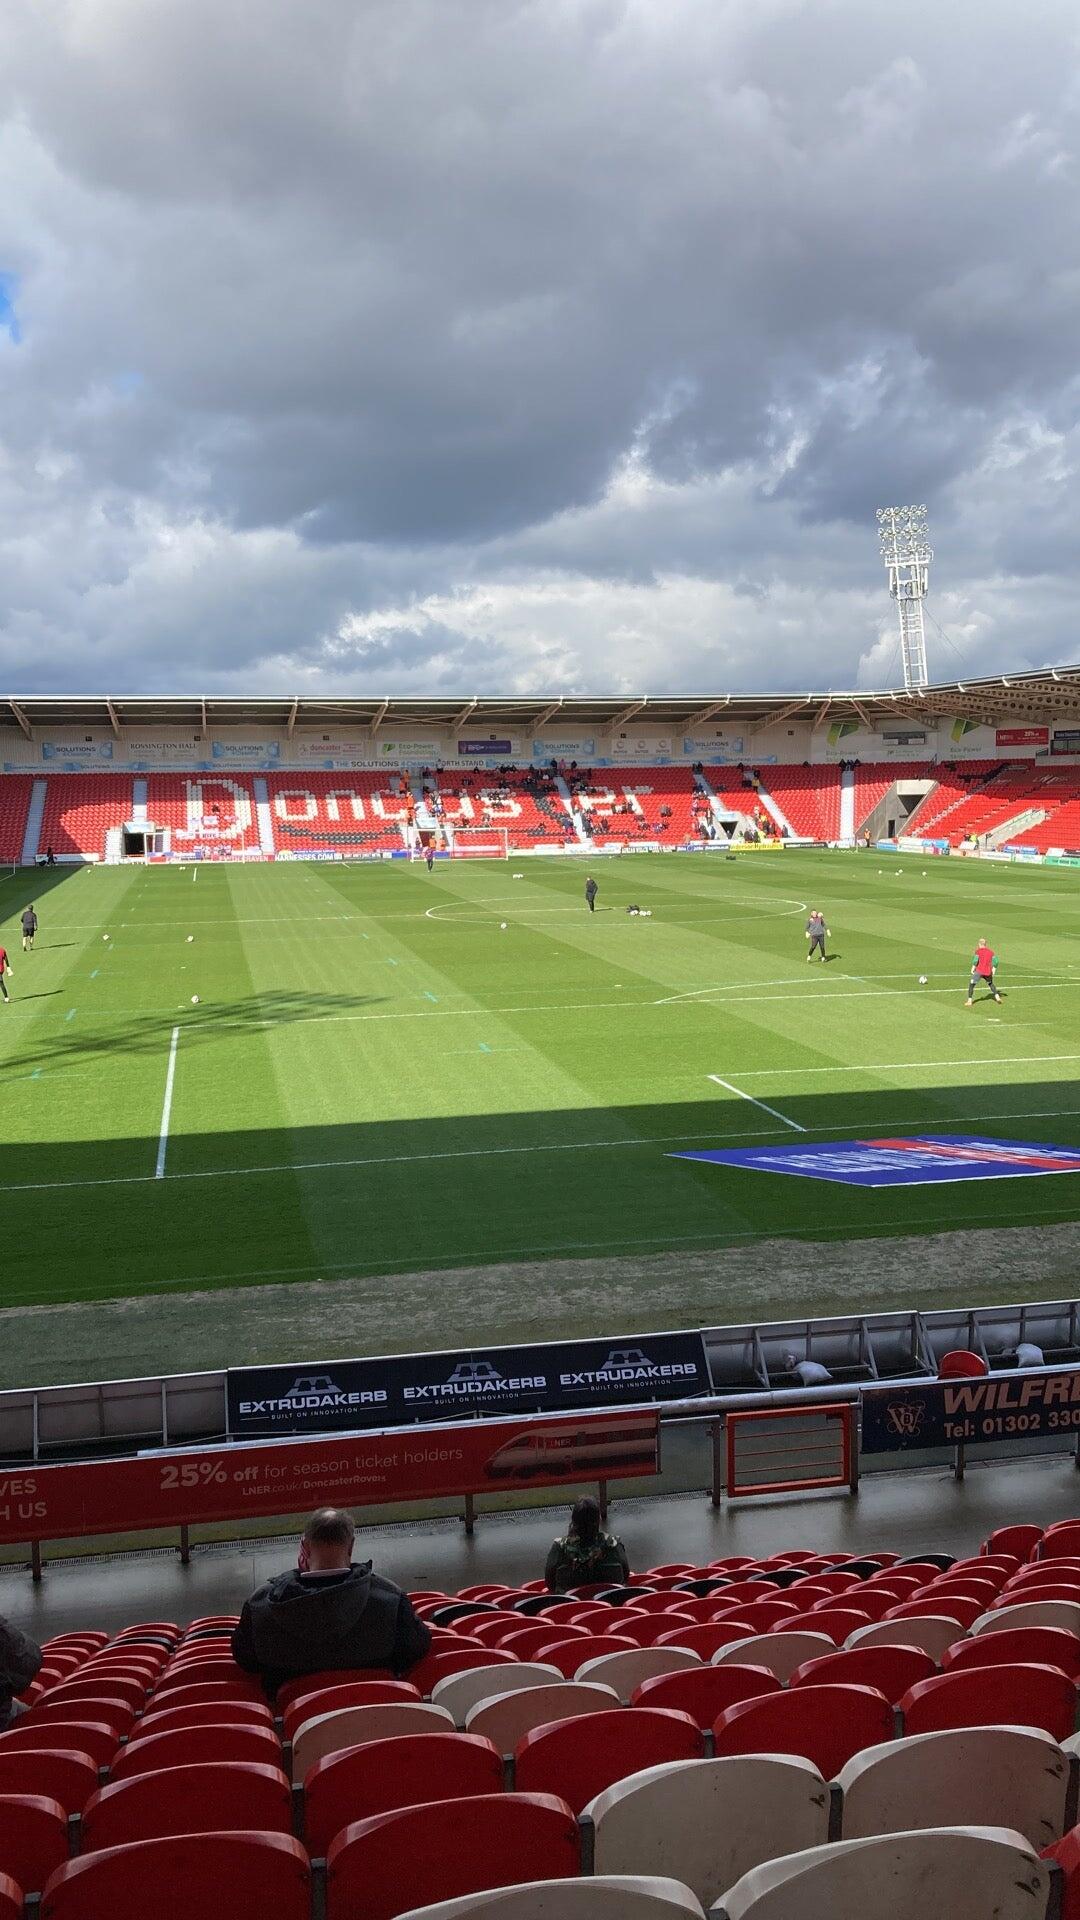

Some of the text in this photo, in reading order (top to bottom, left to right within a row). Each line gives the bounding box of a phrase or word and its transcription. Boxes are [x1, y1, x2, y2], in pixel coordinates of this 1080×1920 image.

[351, 760, 400, 768] SOLUTIONS
[559, 1363, 698, 1386] EXTRUDAKERB
[627, 1379, 671, 1388] INNOVATION
[403, 1376, 547, 1399] EXTRUDAKERB
[472, 1392, 519, 1401] INNOVATION
[239, 1390, 388, 1414] EXTRUDAKERB
[310, 1407, 359, 1416] INNOVATION
[943, 1419, 976, 1438] Tel:
[982, 1413, 1041, 1435] 01302
[160, 1447, 464, 1490] 25% off for season ticket holders
[18, 1501, 47, 1518] US
